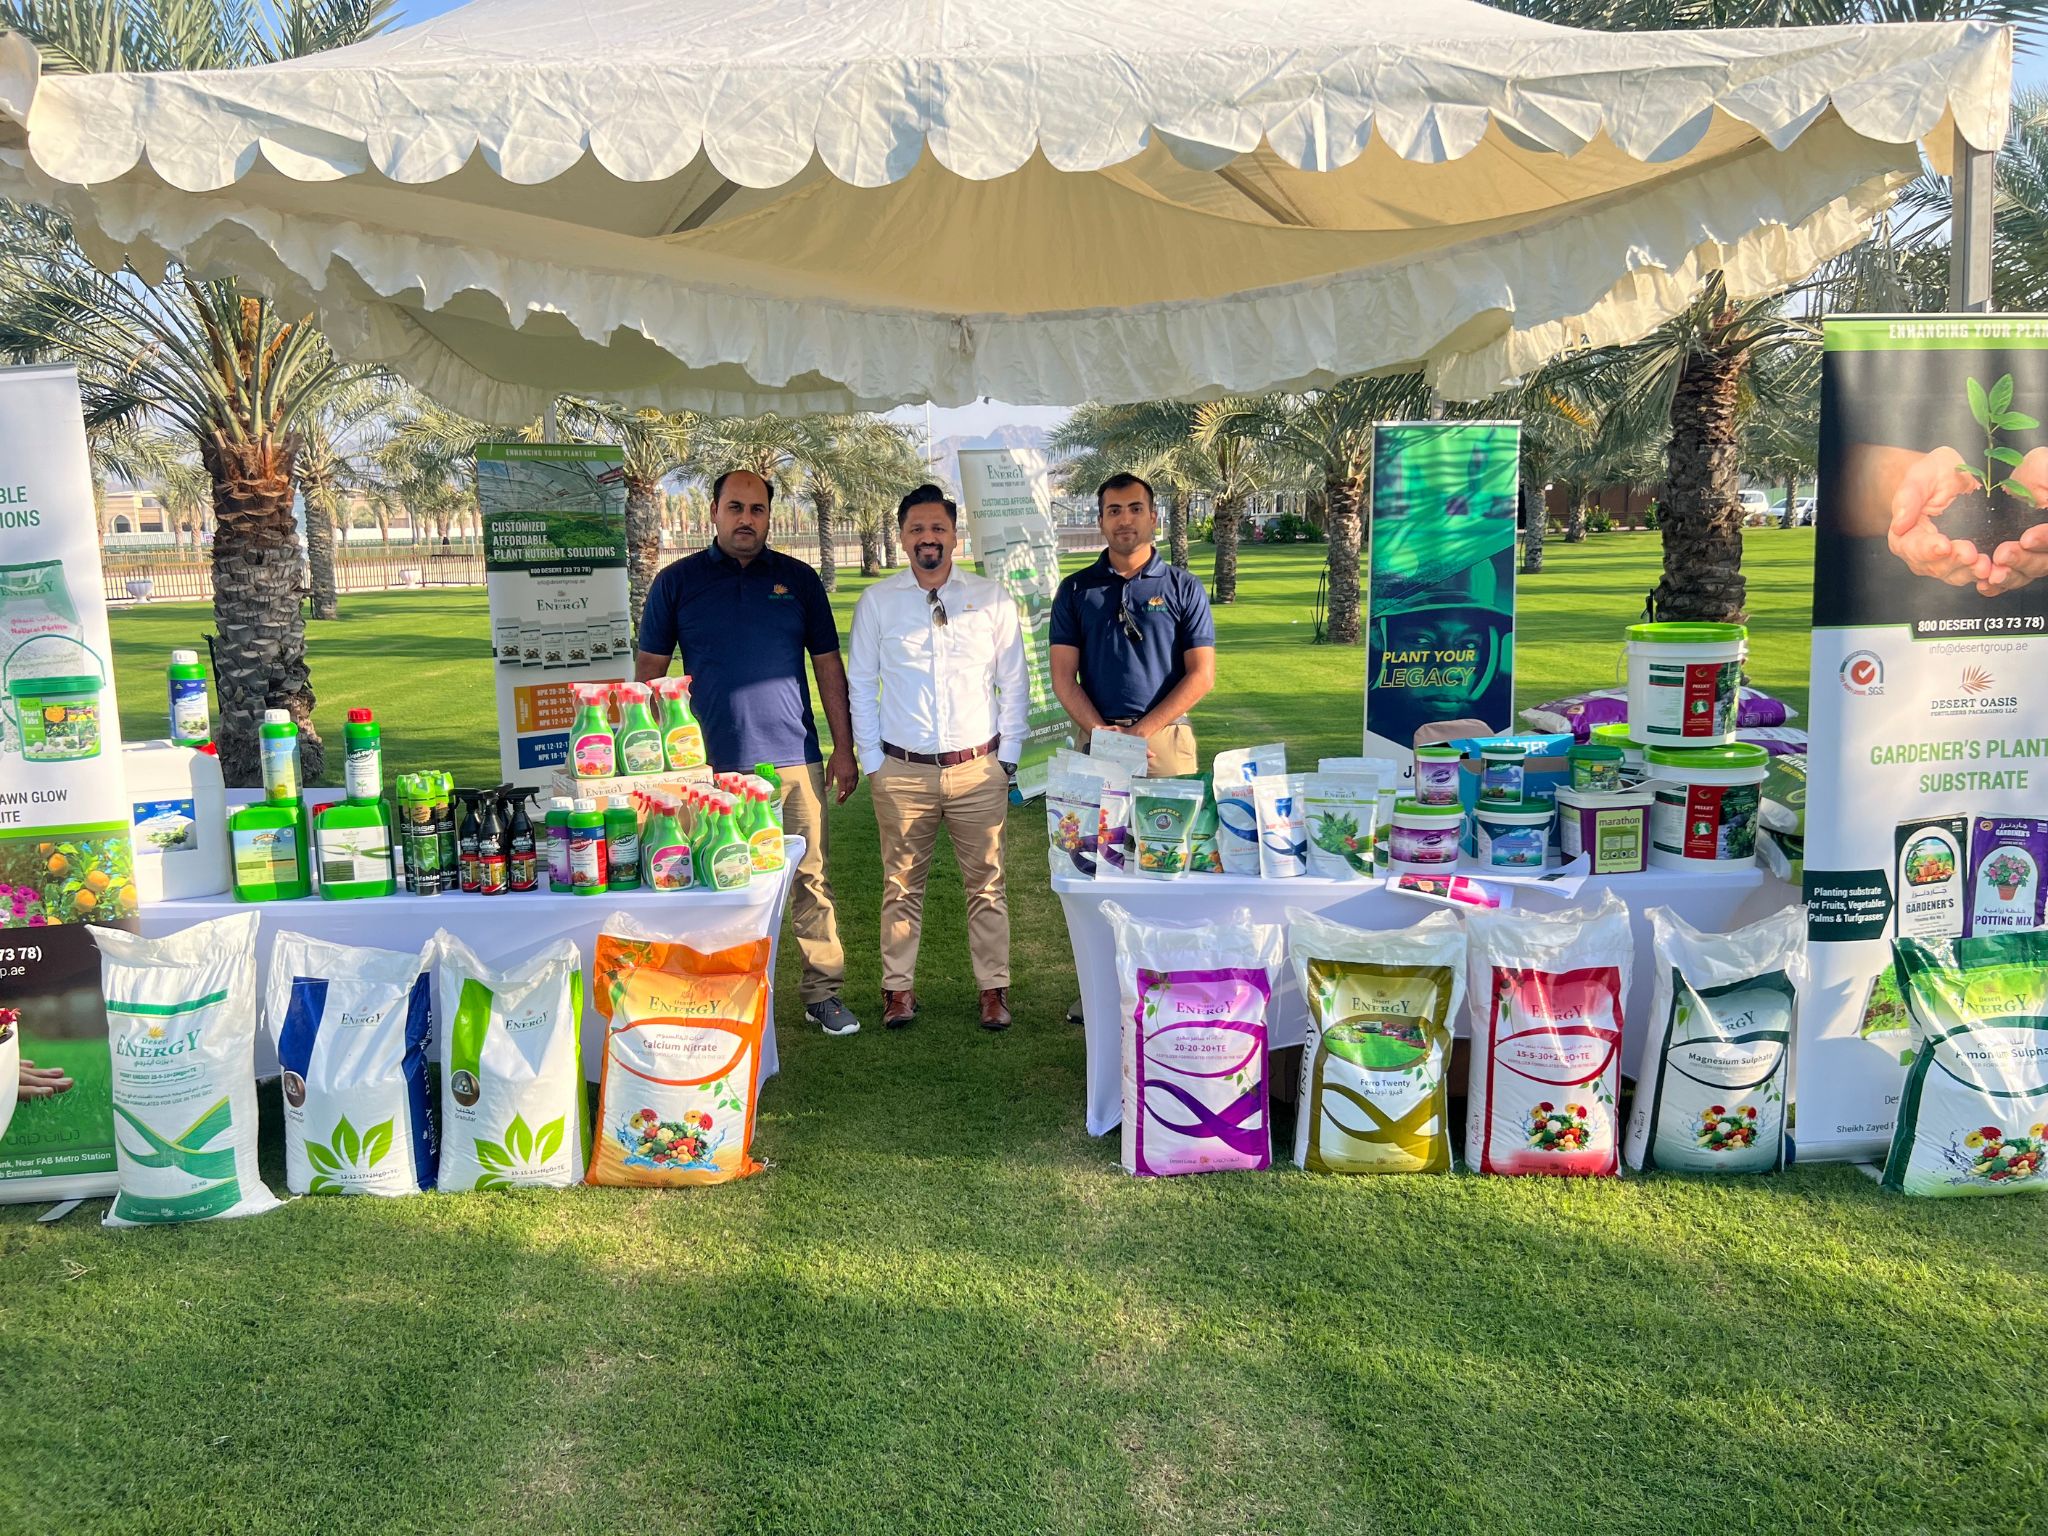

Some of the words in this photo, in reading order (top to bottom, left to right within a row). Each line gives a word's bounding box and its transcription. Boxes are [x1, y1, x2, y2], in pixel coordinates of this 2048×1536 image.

[1889, 324, 1969, 339] ENHANCING
[1974, 323, 2011, 338] YOUR
[505, 449, 542, 457] ENHANCING
[544, 449, 561, 457] YOUR
[1011, 497, 1035, 505] AFFORDA
[492, 522, 546, 532] CUSTOMIZED
[493, 535, 547, 546] AFFORDABLE
[494, 549, 522, 560] PLANT
[525, 548, 565, 558] NUTRIENT
[567, 547, 616, 557] SOLUTIONS
[536, 597, 589, 611] ENERGY
[1918, 621, 1937, 632] 800
[1938, 619, 1982, 631] DESERT
[1984, 618, 2004, 632] (33
[2006, 618, 2022, 630] 73
[2024, 616, 2045, 630] 78)
[1929, 642, 2028, 656] info@desertgroup.ae
[1382, 651, 1428, 664] PLANT
[1434, 649, 1475, 663] YOUR
[1379, 665, 1475, 688] LEGACY
[1868, 687, 1884, 695] SGS
[1931, 698, 1977, 709] DESERT
[1980, 697, 2018, 707] OASIS
[547, 742, 569, 750] 12-12-1
[1870, 739, 1980, 765] GARDENER'S
[1919, 770, 2028, 793] SUBSTRATE
[32, 790, 67, 803] GLOW
[586, 784, 623, 796] ENERGY
[1599, 816, 1640, 826] marathon
[1814, 887, 1848, 898] Planting
[1849, 887, 1882, 896] substrate
[1808, 900, 1820, 909] for
[1821, 900, 1847, 910] Fruits,
[1848, 899, 1886, 911] Vegetables
[1906, 898, 1954, 914] GARDENER'S
[1809, 914, 1834, 922] Palms
[1836, 914, 1842, 922] &
[1843, 913, 1884, 924] Turfgrasses
[1975, 915, 2012, 926] POTTING
[2016, 916, 2032, 925] MIX
[18, 946, 43, 961] 78)
[649, 996, 721, 1014] ENERGY
[1176, 1000, 1234, 1014] ENERGY
[1352, 997, 1410, 1014] ENERGY
[1955, 993, 2028, 1014] NERGY
[341, 1013, 384, 1025] ENERGY
[1532, 1004, 1583, 1021] ERGY
[505, 1011, 548, 1030] ENERGY
[116, 1029, 202, 1058] ENERGY
[643, 1040, 680, 1051] Calcium
[684, 1043, 717, 1052] Nitrate
[1174, 1044, 1227, 1053] 20-20-20+TE
[1300, 1024, 1317, 1097] ENERGY
[1516, 1050, 1590, 1063] 15-5-30+2gO+TE
[1688, 1053, 1739, 1065] Magnesium
[1741, 1053, 1773, 1064] Sulphate
[1360, 1079, 1380, 1087] Ferro
[1382, 1079, 1410, 1088] Twenty
[455, 1113, 476, 1122] Granular
[1836, 1124, 1864, 1133] Sheikh
[1866, 1123, 1889, 1134] Zayed
[15, 1159, 34, 1167] Near
[36, 1157, 53, 1165] FAB
[55, 1155, 79, 1163] Metro
[81, 1152, 111, 1160] Station
[6, 1169, 42, 1178] Emirates
